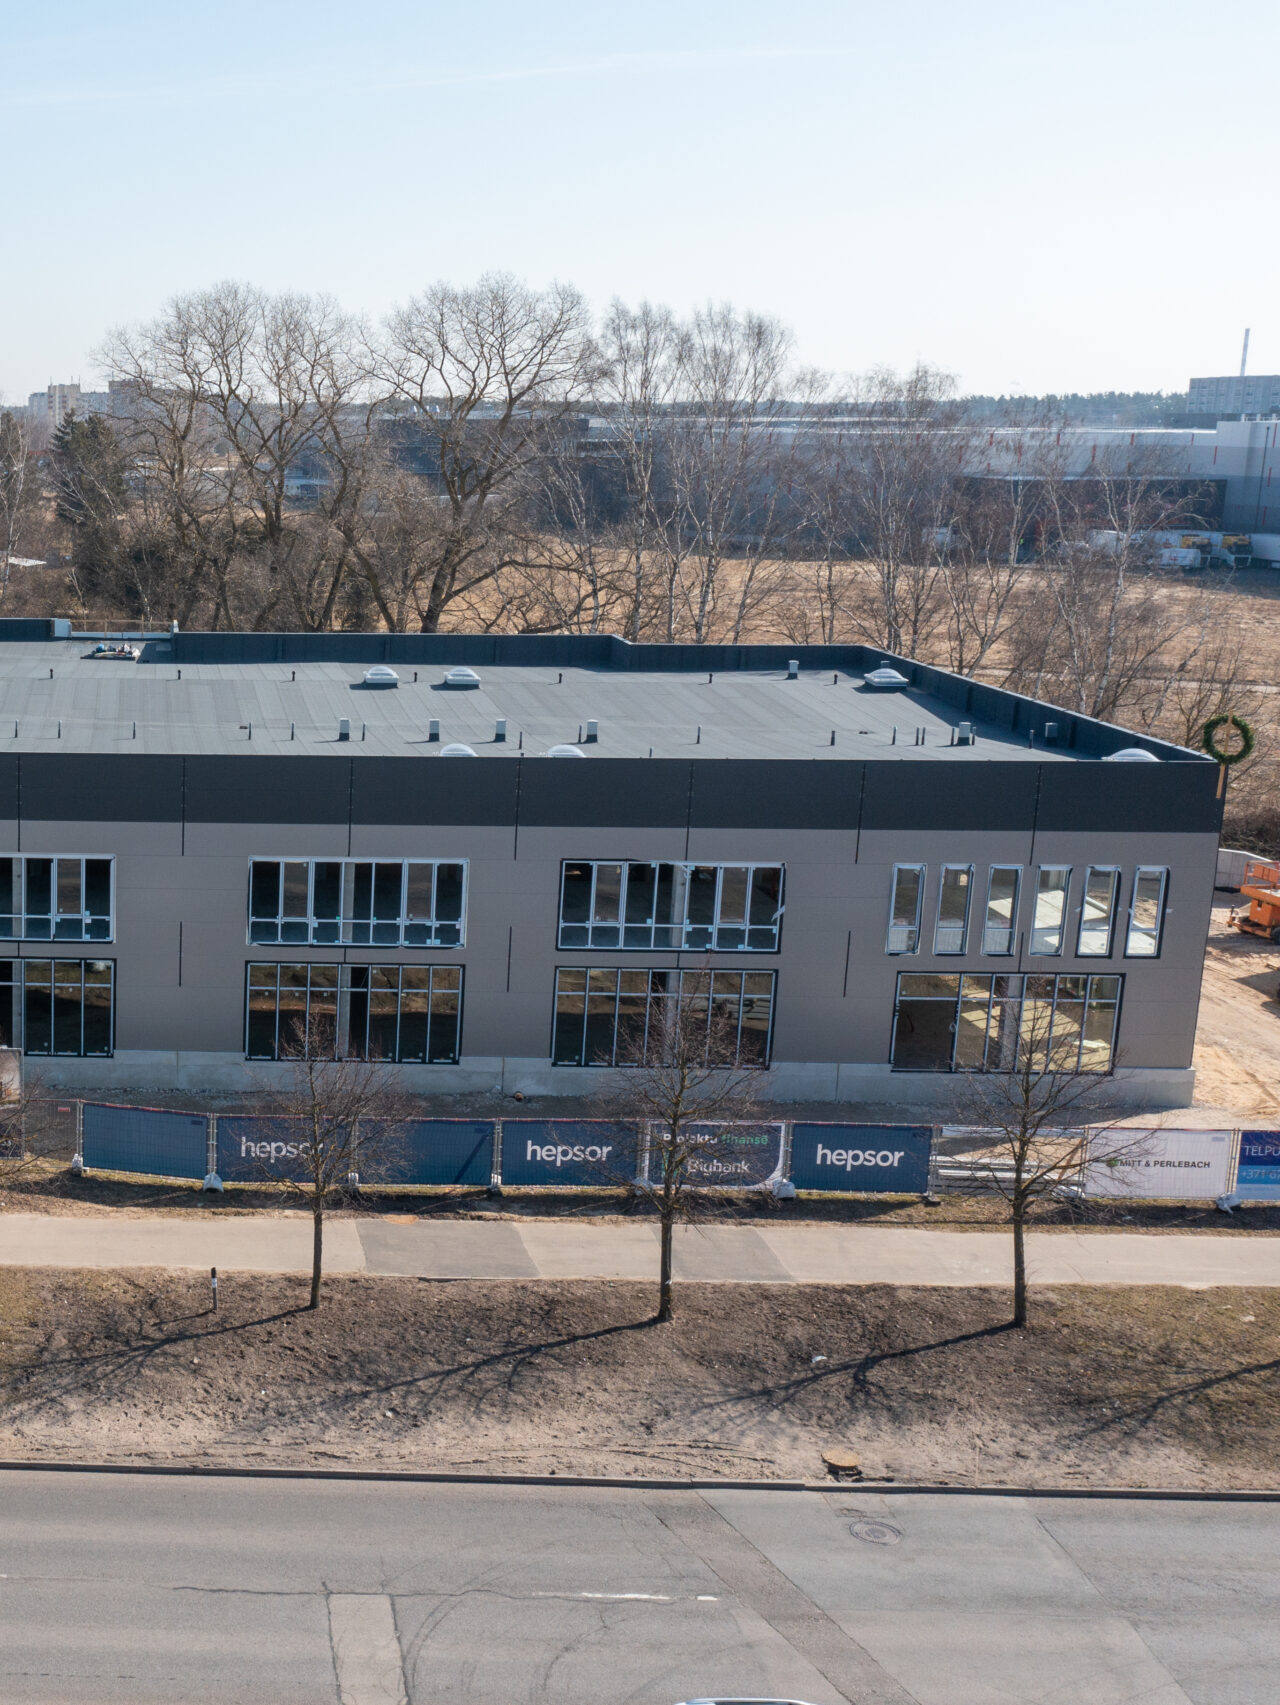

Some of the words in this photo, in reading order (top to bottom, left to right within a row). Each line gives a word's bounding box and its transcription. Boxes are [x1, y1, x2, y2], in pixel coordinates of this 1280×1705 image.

[526, 1140, 612, 1167] hepsor
[817, 1144, 904, 1171] hepsor
[1154, 1160, 1211, 1168] PERLEBACH
